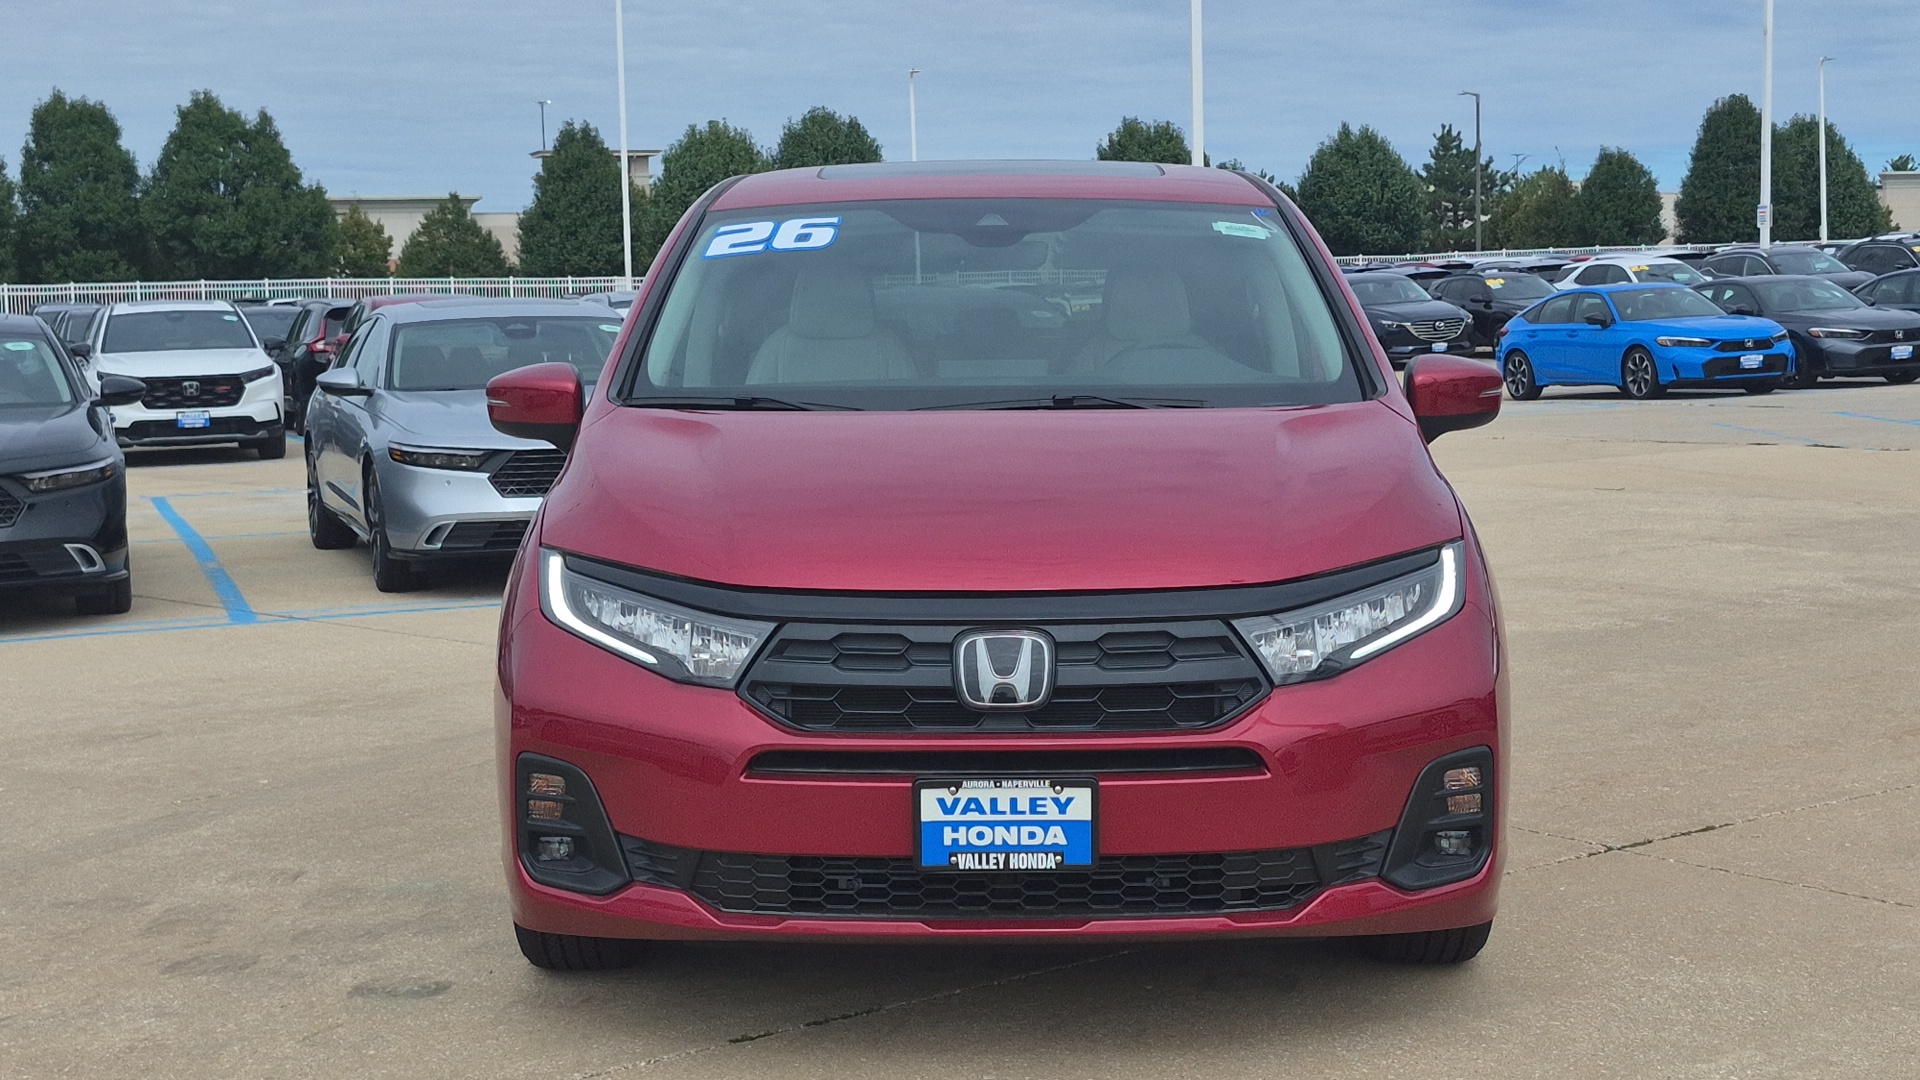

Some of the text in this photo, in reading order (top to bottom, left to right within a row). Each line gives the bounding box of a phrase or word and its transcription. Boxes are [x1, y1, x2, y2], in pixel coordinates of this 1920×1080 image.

[703, 216, 842, 259] 26
[962, 780, 1051, 788] AURORA NAPERVILLE
[935, 797, 1075, 815] VALLEY
[943, 826, 1068, 846] HONDA
[957, 853, 1056, 869] VALLEY HONDA
